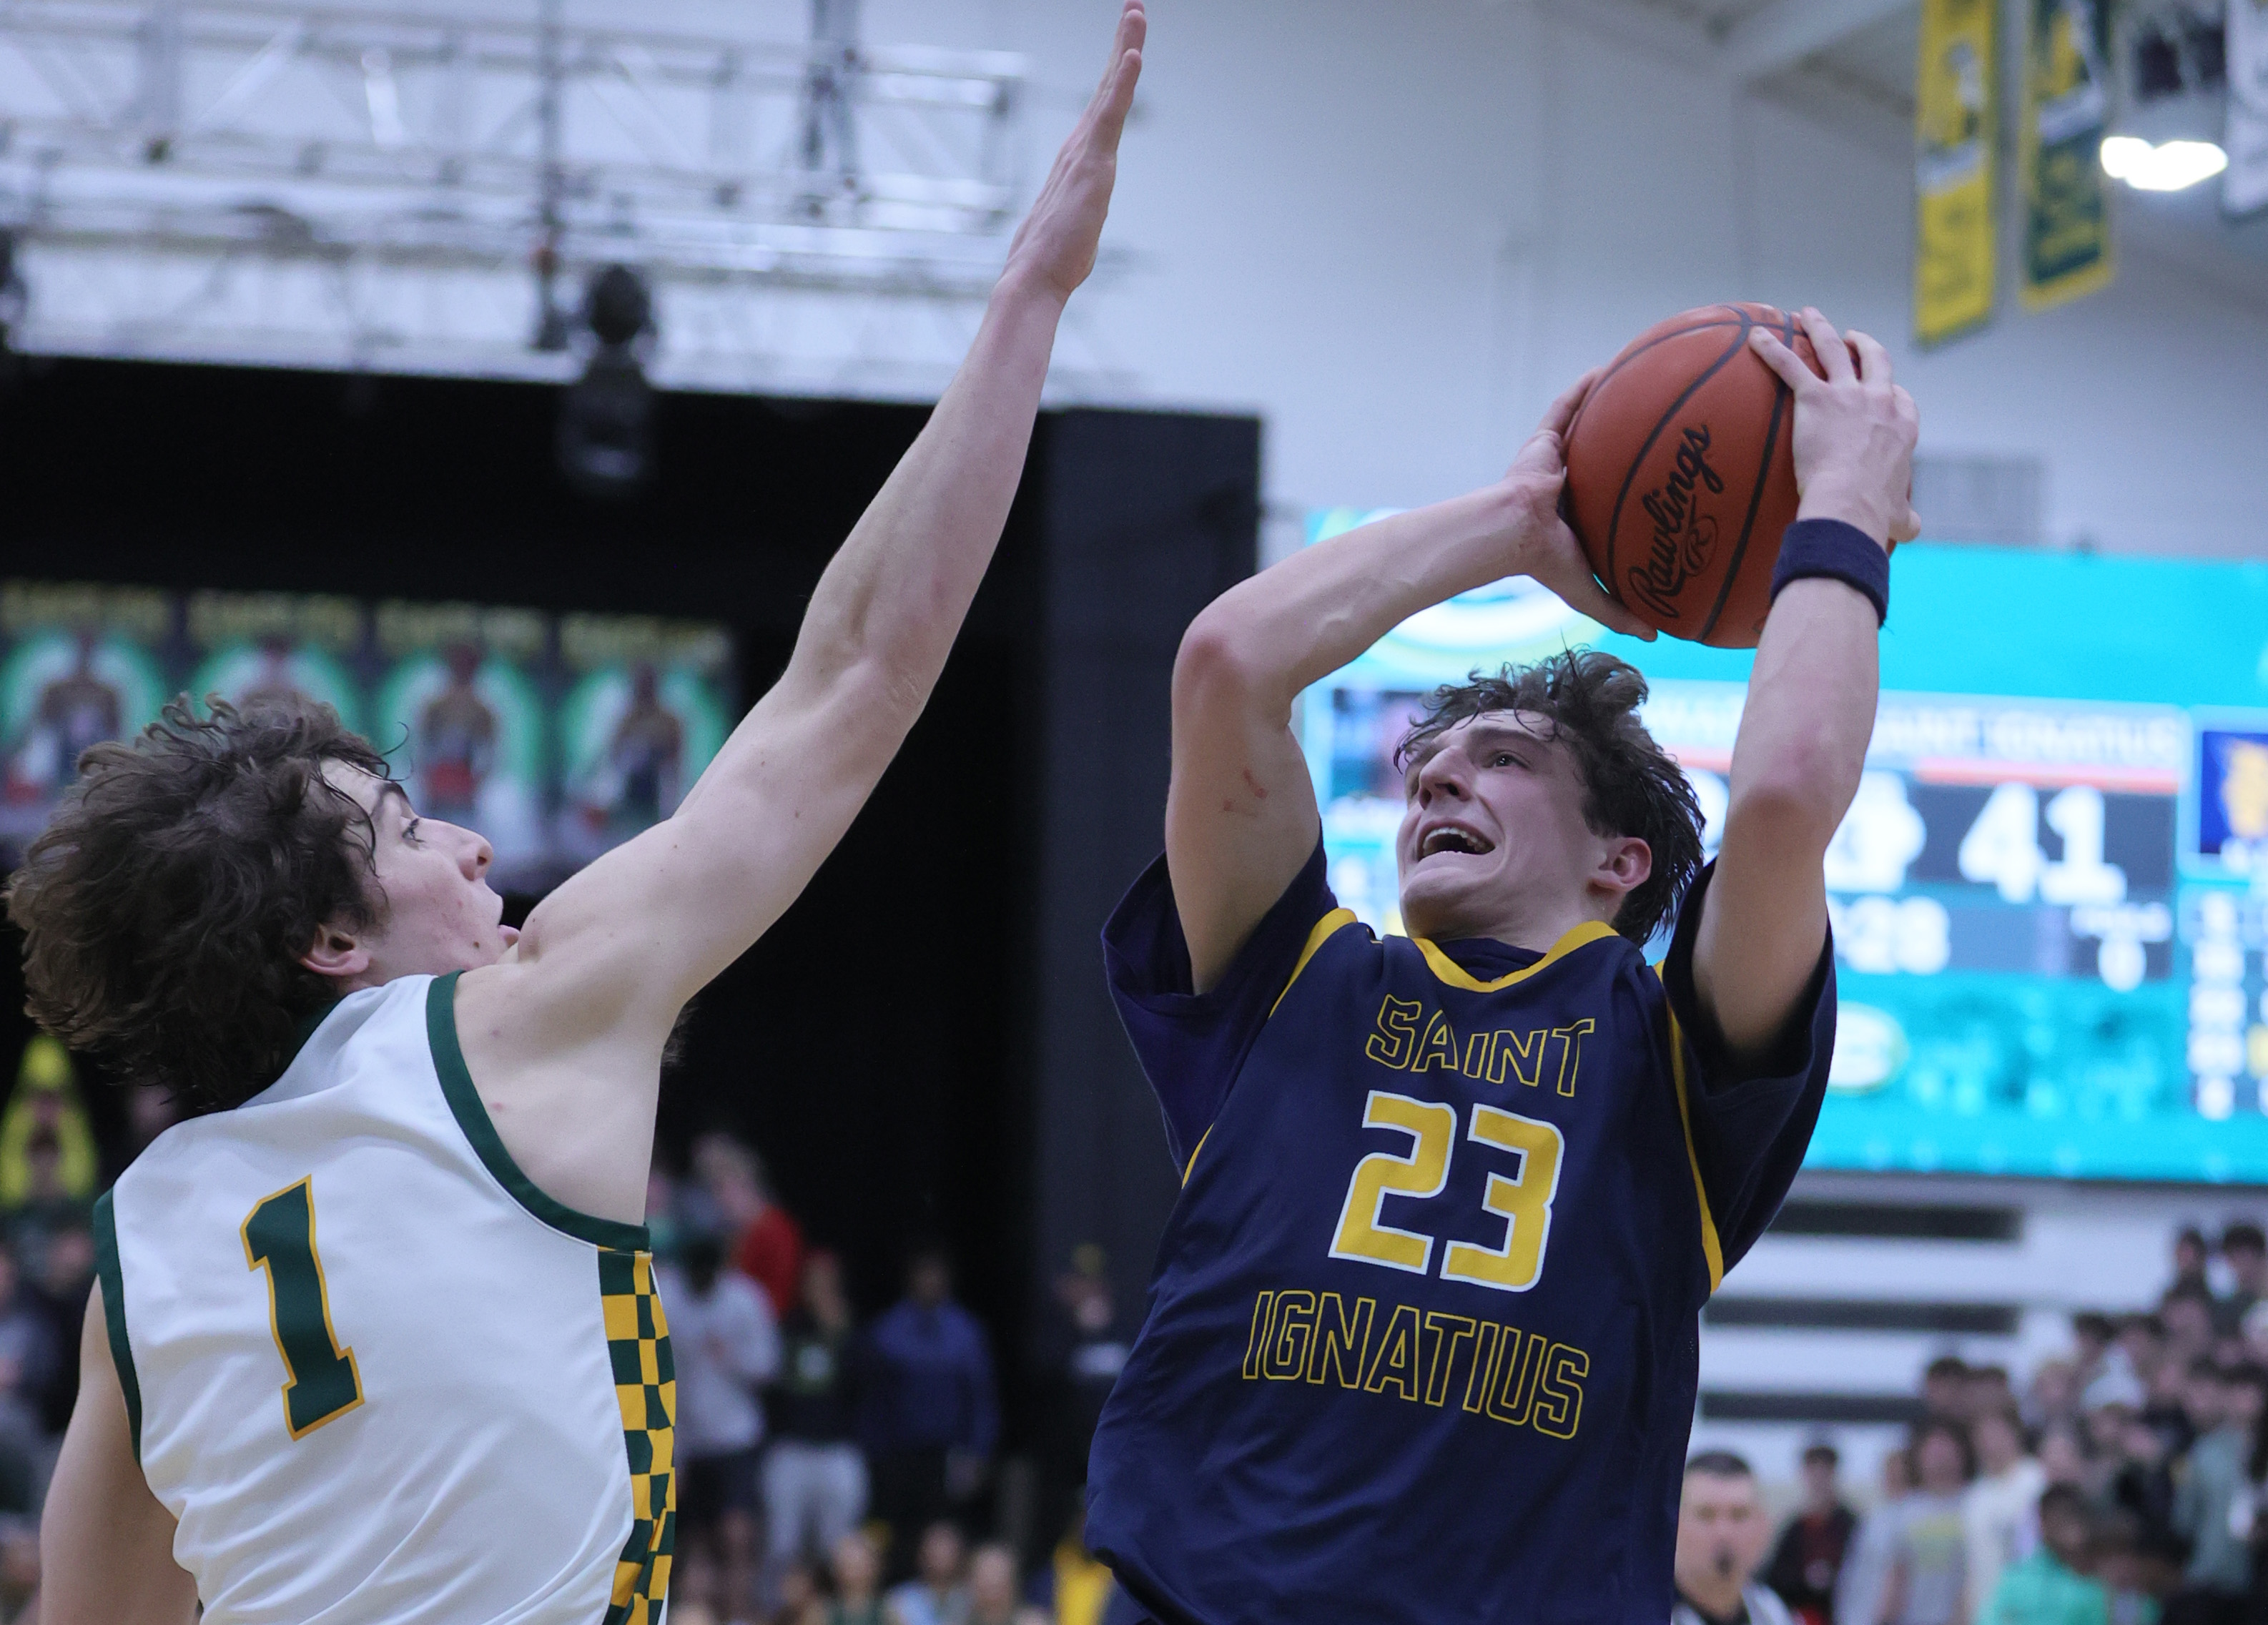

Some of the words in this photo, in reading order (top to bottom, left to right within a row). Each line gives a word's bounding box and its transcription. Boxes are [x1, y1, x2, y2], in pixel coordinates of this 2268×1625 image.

[1628, 424, 1724, 618] Rawlings
[1959, 784, 2126, 904] 41
[1365, 994, 1595, 1097] SAINT
[1328, 1090, 1565, 1293] 23
[240, 1173, 365, 1442] 1
[1242, 1290, 1589, 1440] IGNATIUS
